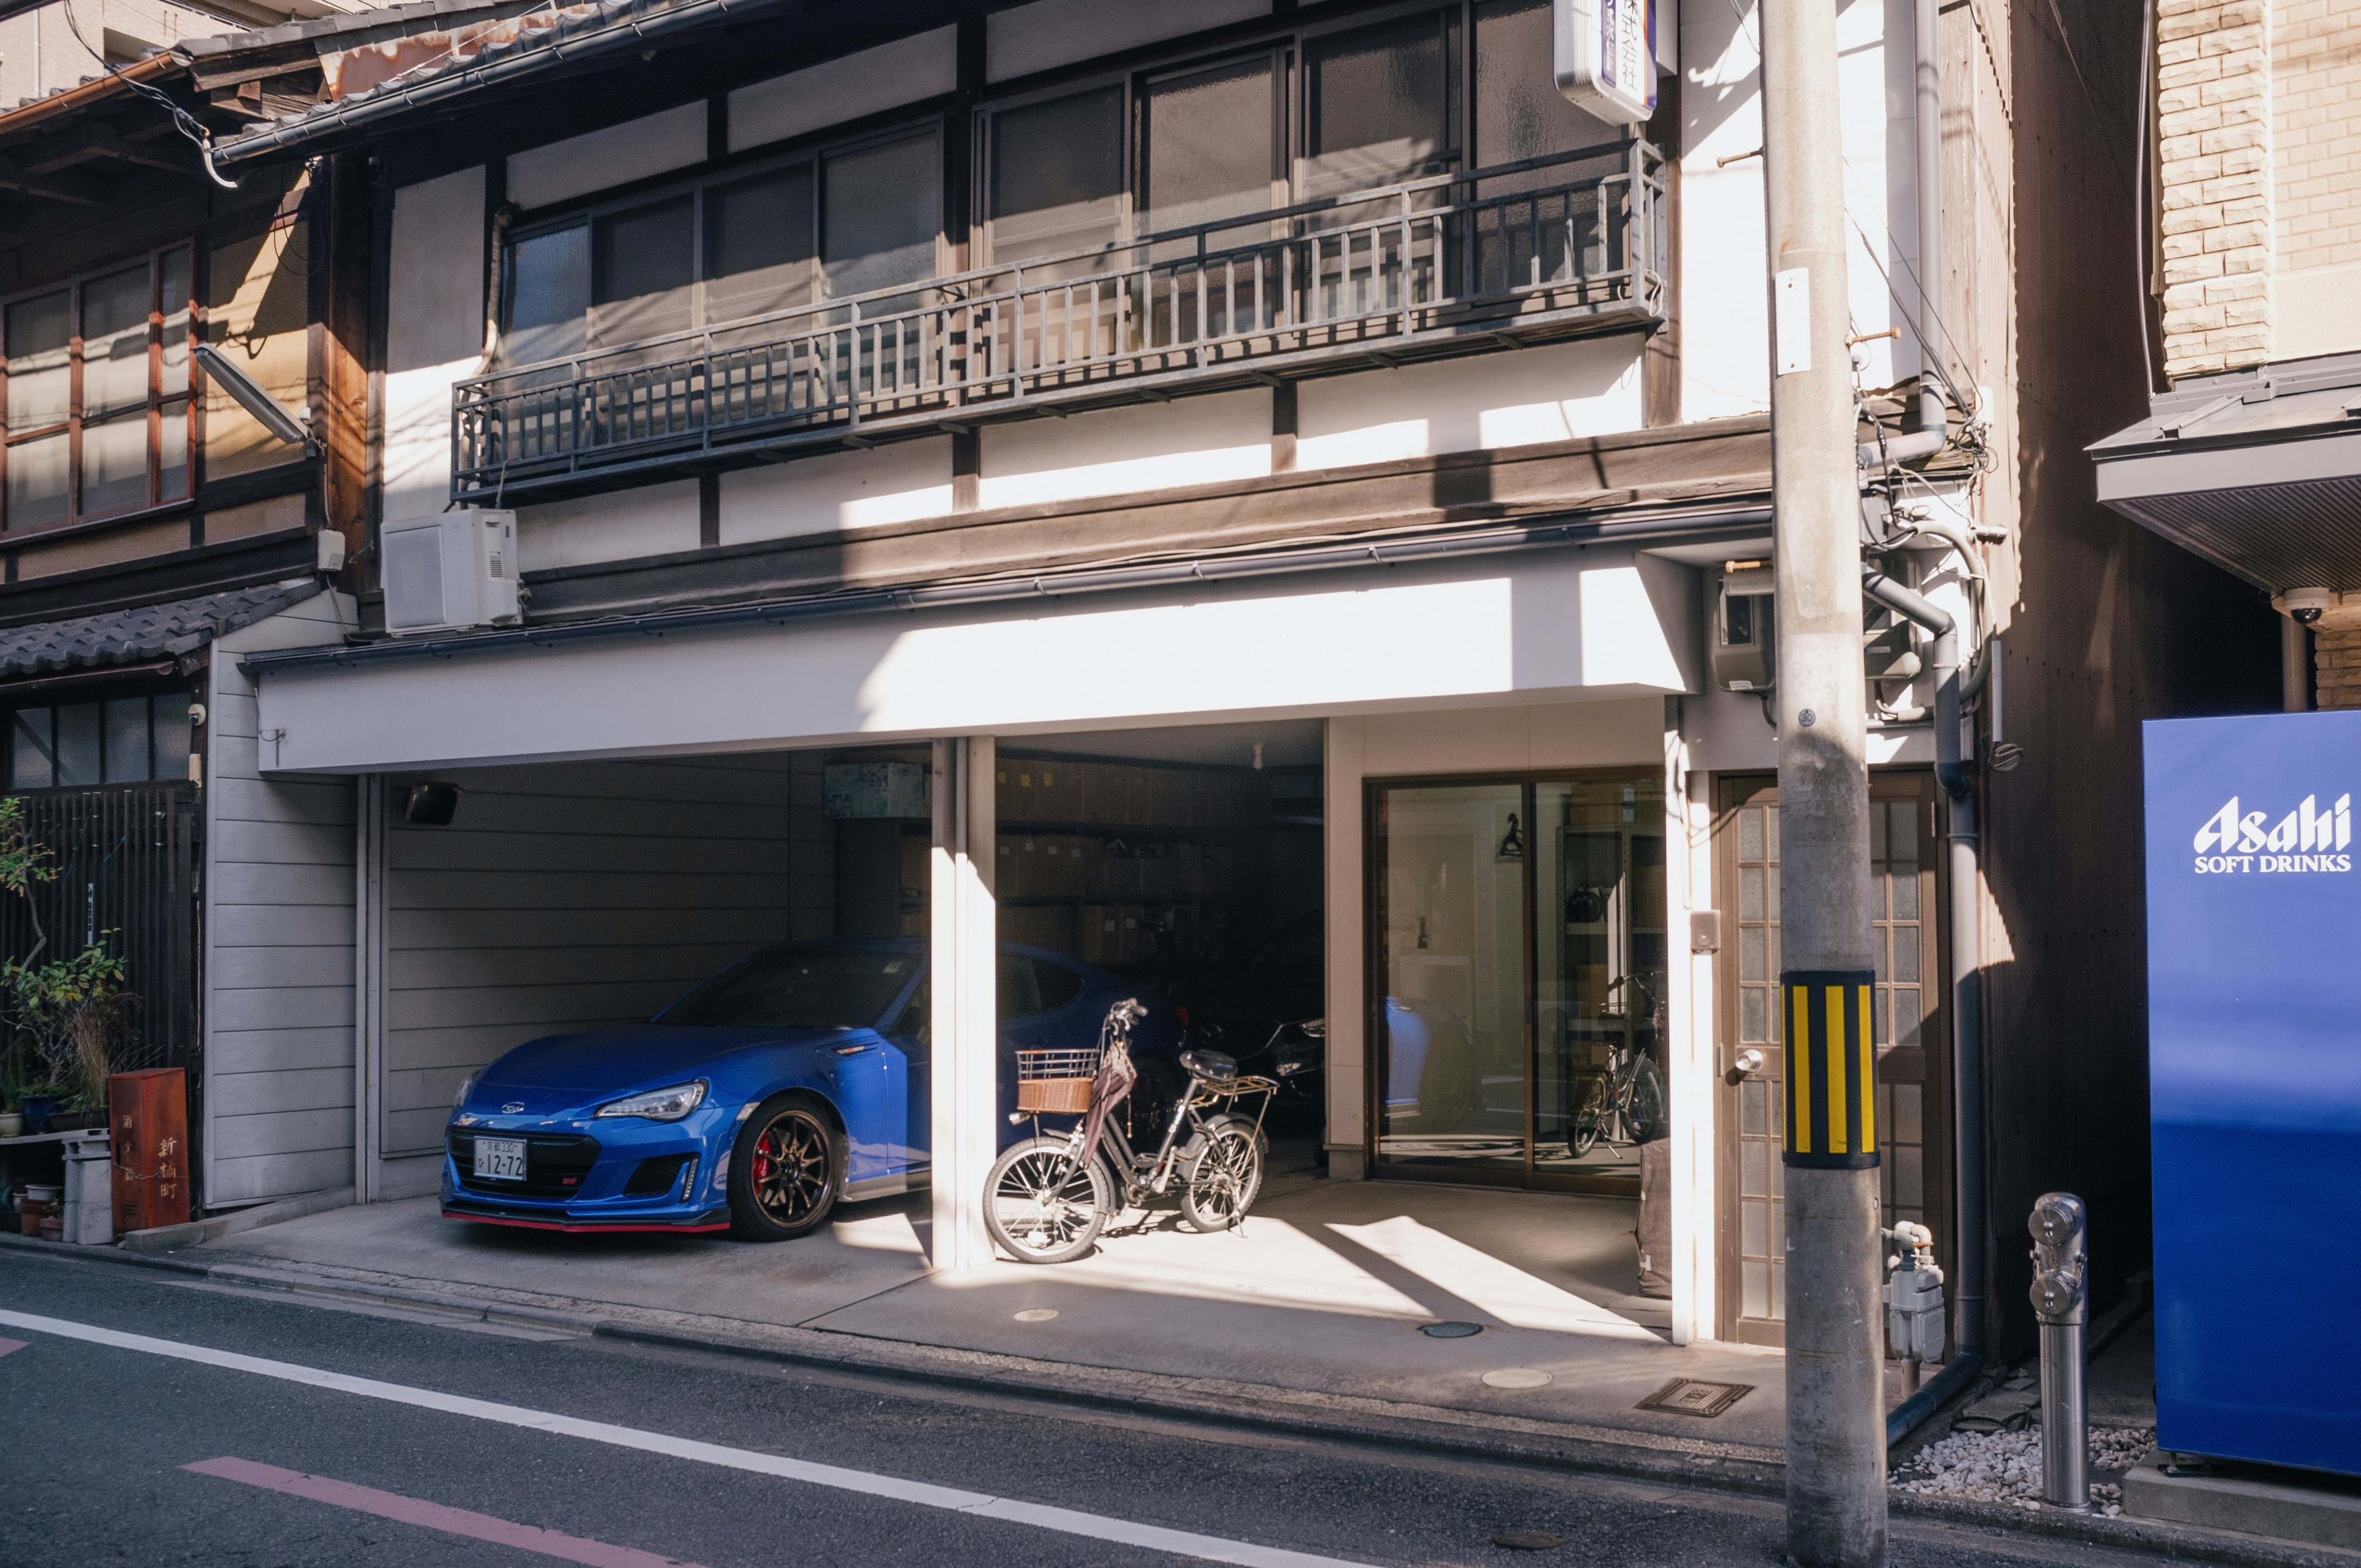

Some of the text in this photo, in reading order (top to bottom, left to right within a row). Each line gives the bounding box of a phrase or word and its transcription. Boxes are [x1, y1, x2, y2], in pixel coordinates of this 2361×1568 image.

[1801, 713, 1813, 722] 30
[2194, 793, 2351, 853] Asahi
[2195, 854, 2351, 873] SOFT DRINKS
[488, 1154, 523, 1176] 12-72
